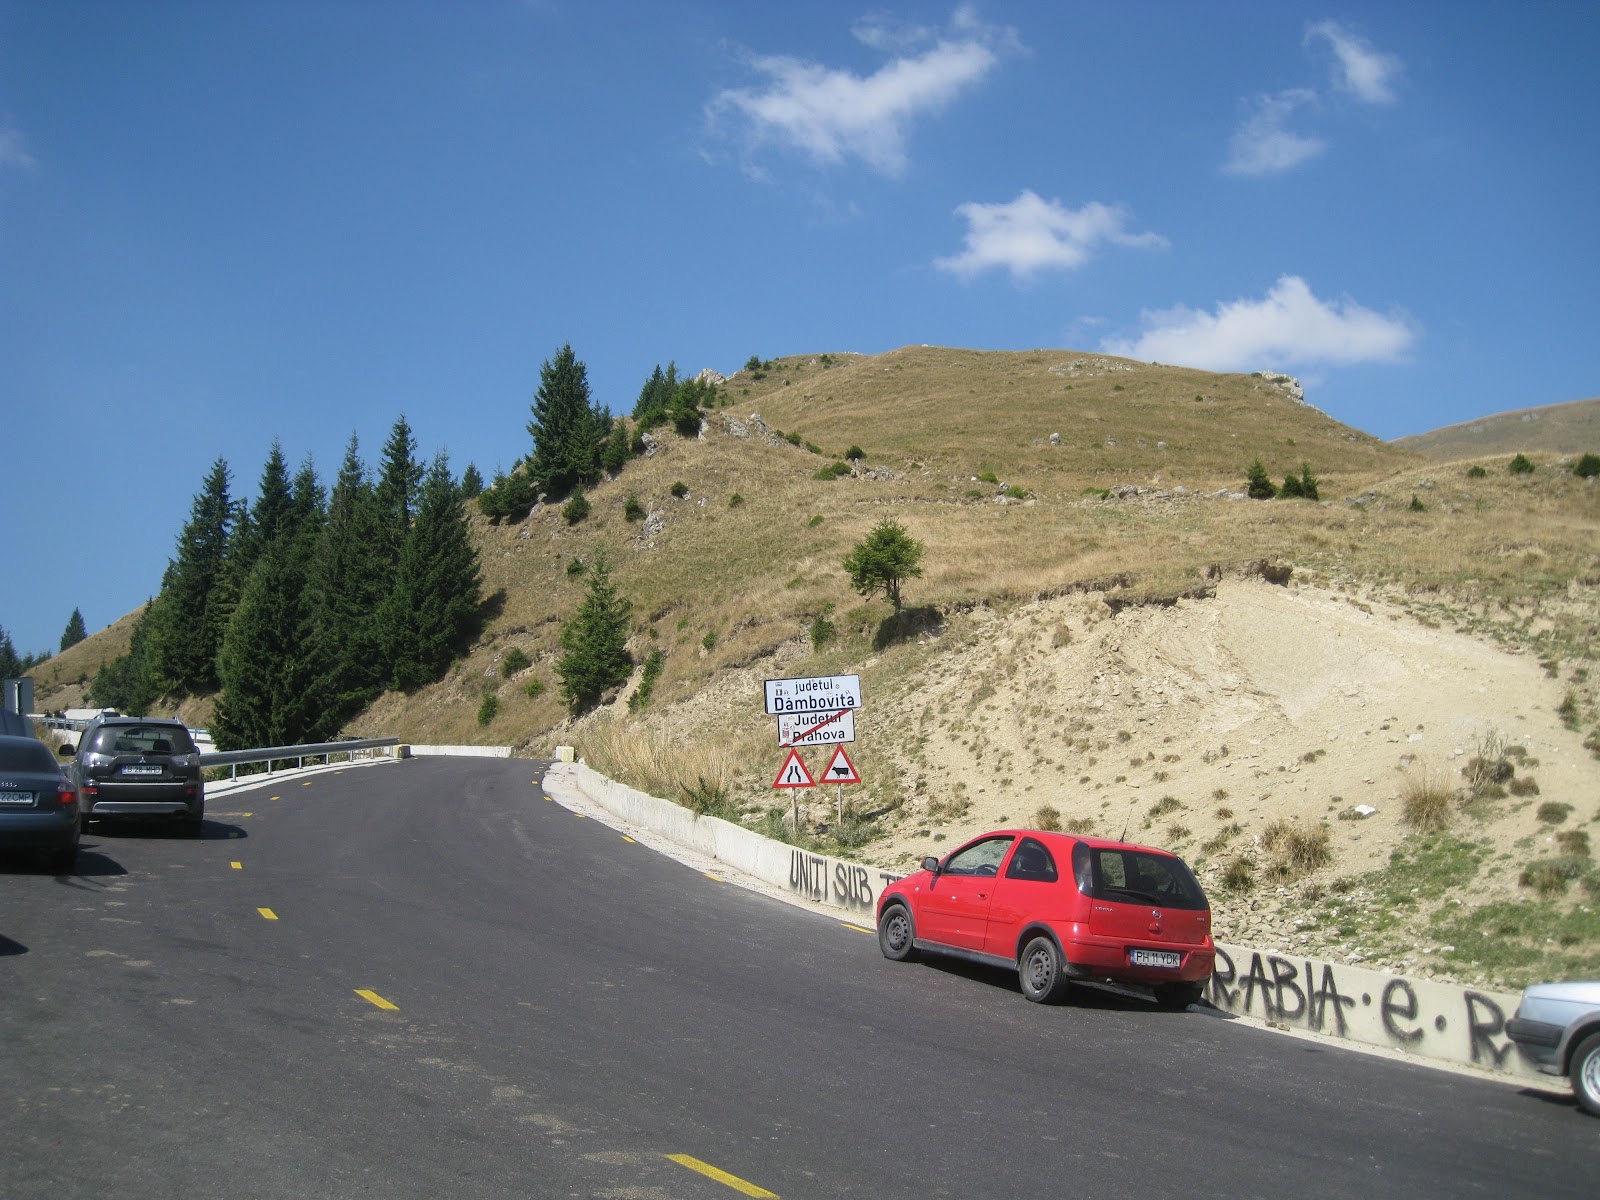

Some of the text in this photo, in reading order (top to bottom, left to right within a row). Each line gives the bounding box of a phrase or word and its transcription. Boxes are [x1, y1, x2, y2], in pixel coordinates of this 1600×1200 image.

[793, 730, 845, 742] Prahova
[833, 862, 874, 909] SUB
[1136, 951, 1150, 963] PH
[1152, 952, 1158, 963] 11
[1161, 953, 1178, 965] YDK
[1203, 946, 1356, 1038] RABIA
